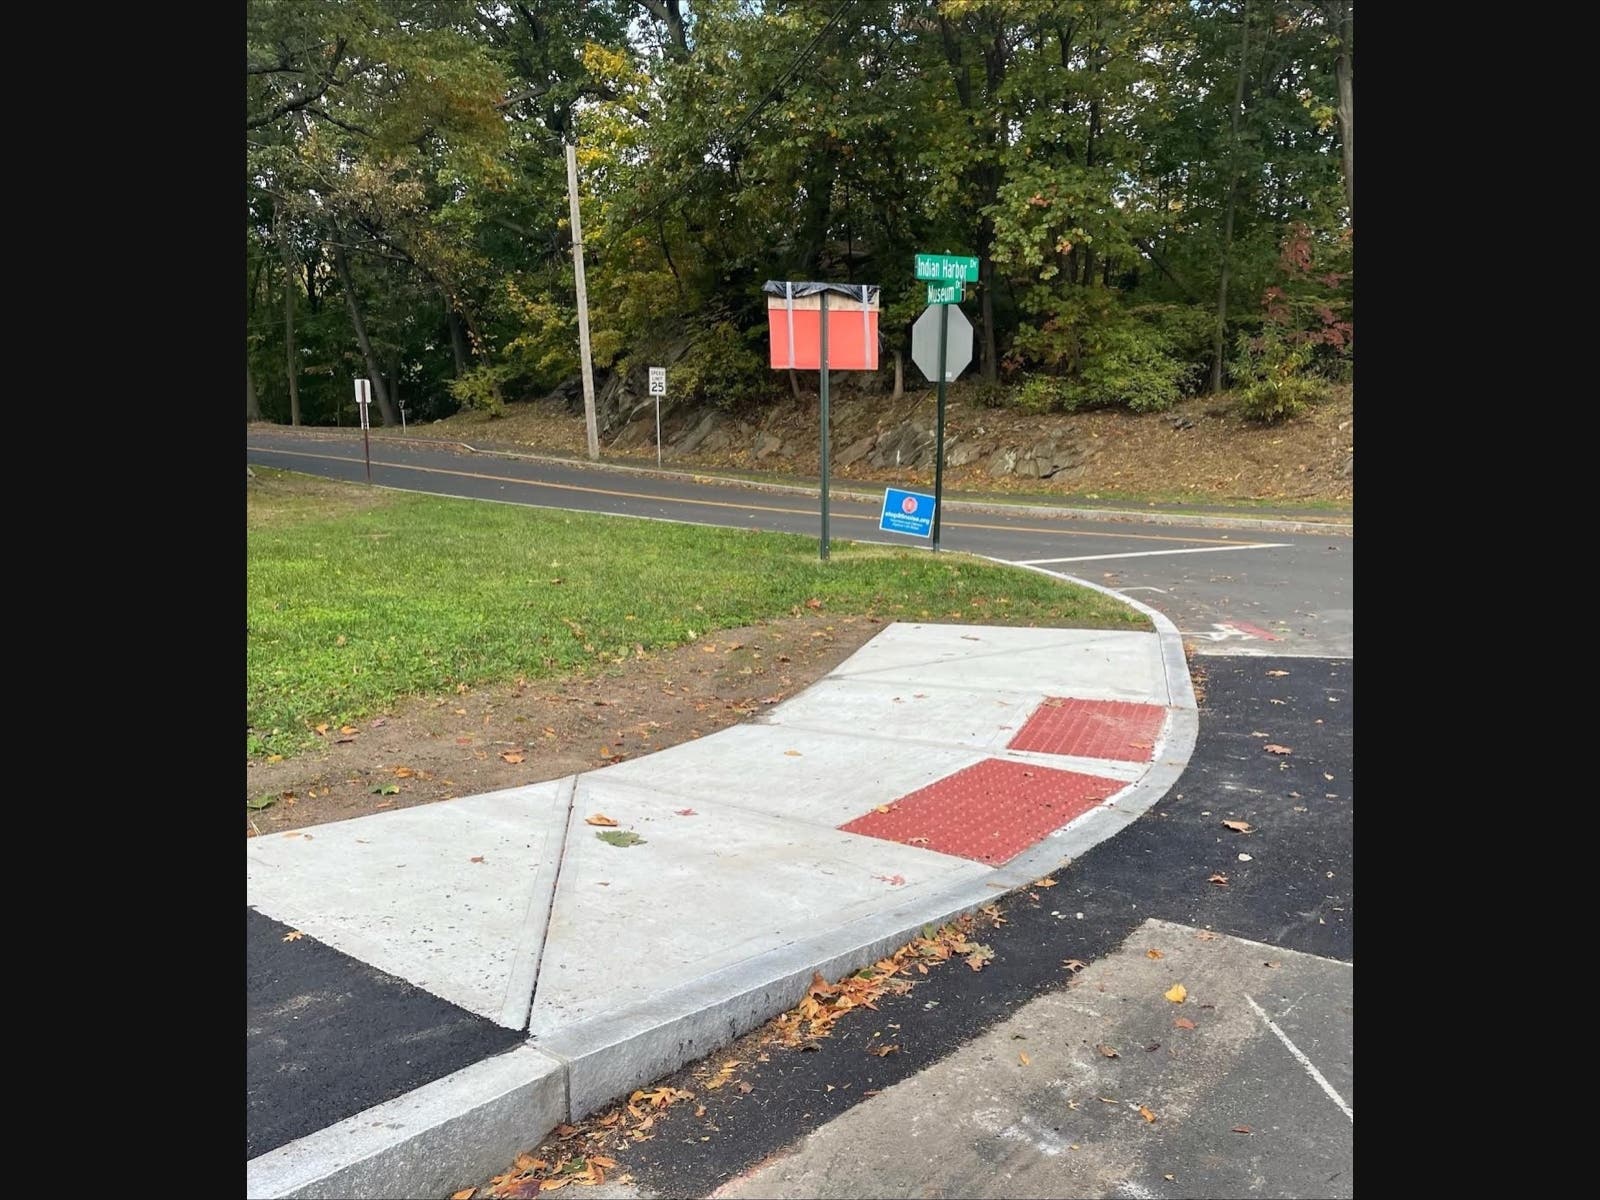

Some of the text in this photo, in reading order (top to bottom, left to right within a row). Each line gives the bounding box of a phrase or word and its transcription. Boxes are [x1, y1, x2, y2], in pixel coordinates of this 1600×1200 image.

[918, 257, 978, 279] Indian Harbor Dr
[928, 285, 954, 304] Museum
[651, 381, 664, 392] 25
